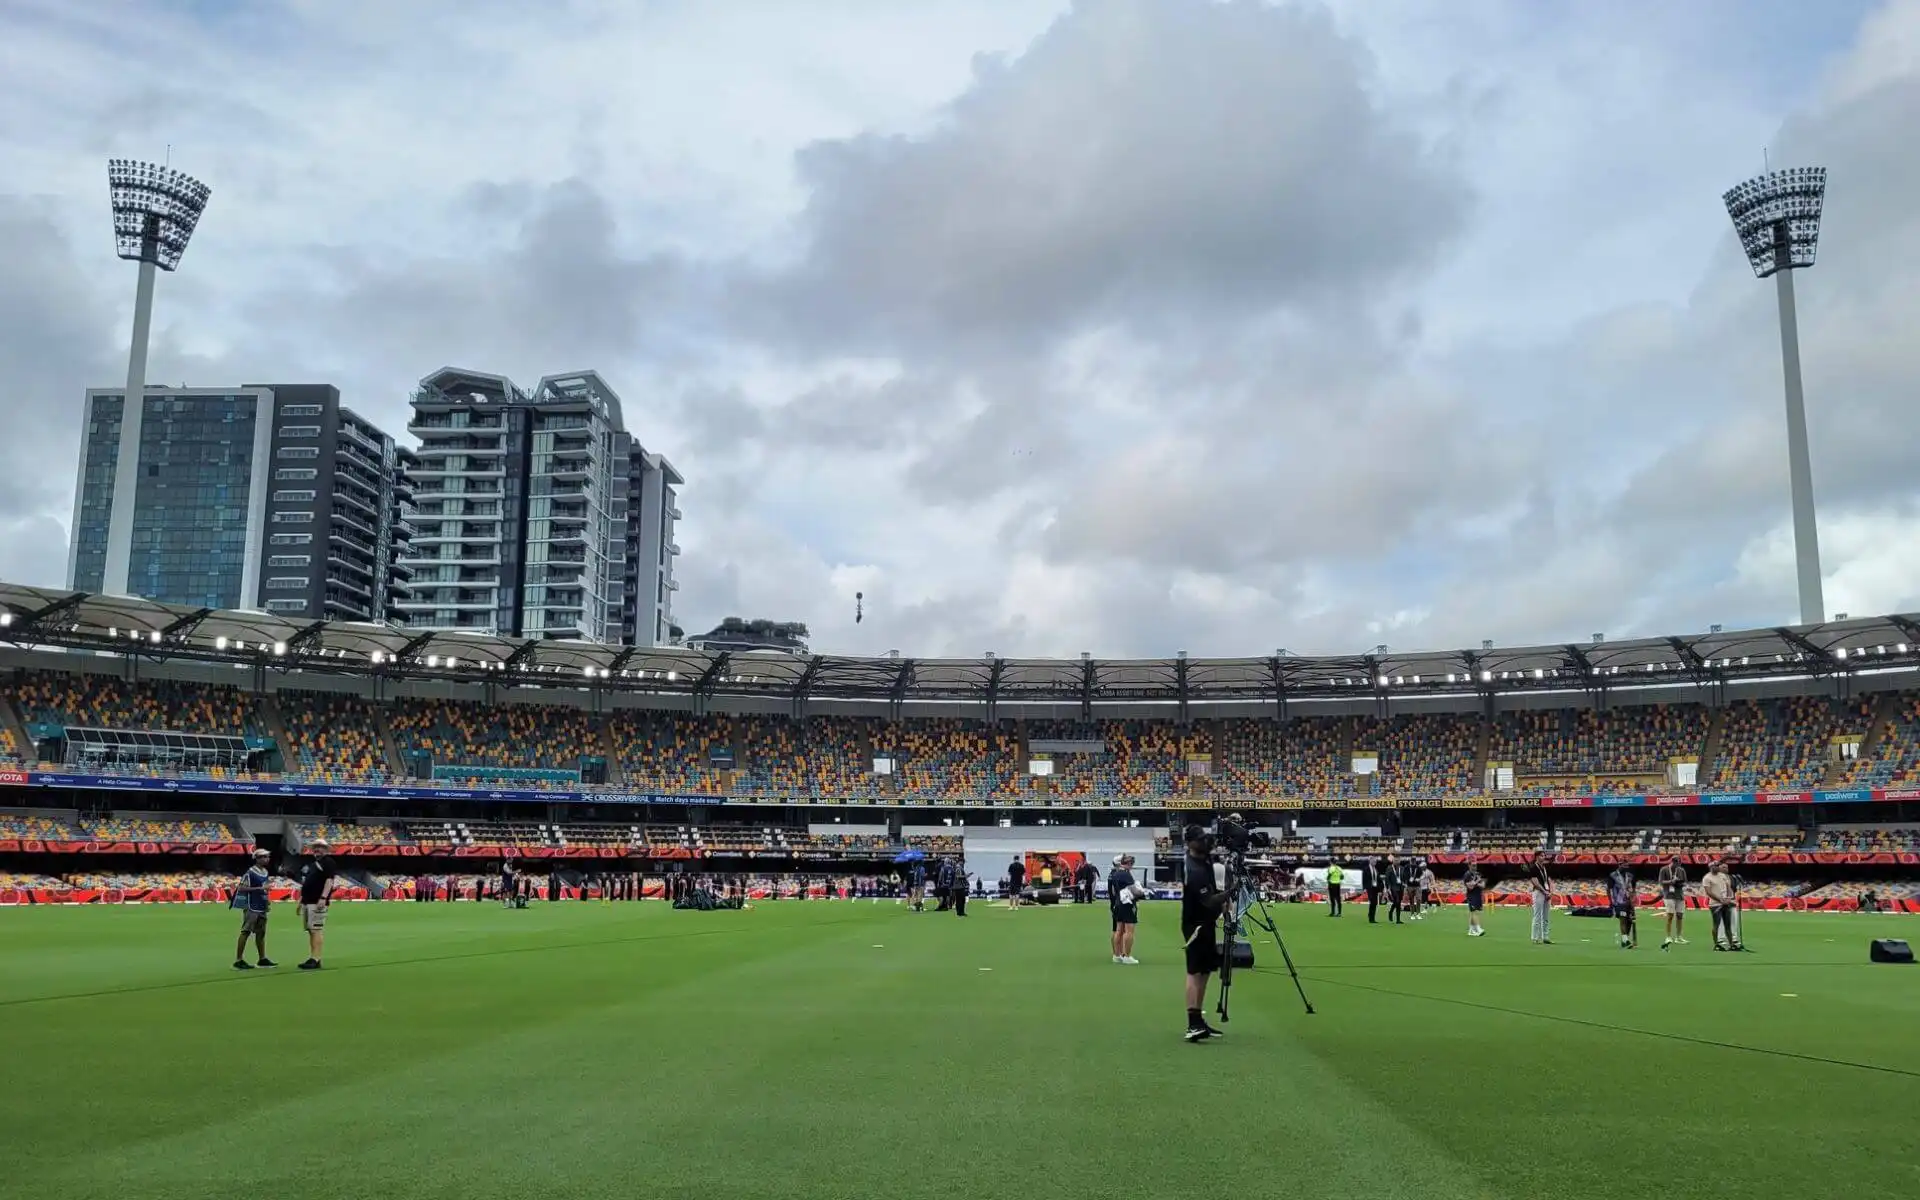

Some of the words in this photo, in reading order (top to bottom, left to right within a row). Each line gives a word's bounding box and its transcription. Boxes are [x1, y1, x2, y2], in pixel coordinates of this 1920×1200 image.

[1166, 800, 1210, 808] NATIONAL
[1256, 800, 1302, 808] NATIONAL
[1304, 800, 1347, 808] STORAGE
[1348, 800, 1395, 808] NATIONAL
[1397, 800, 1442, 808] STORAGE
[1443, 799, 1493, 807] NATIONAL
[1495, 798, 1540, 807] STORAGE
